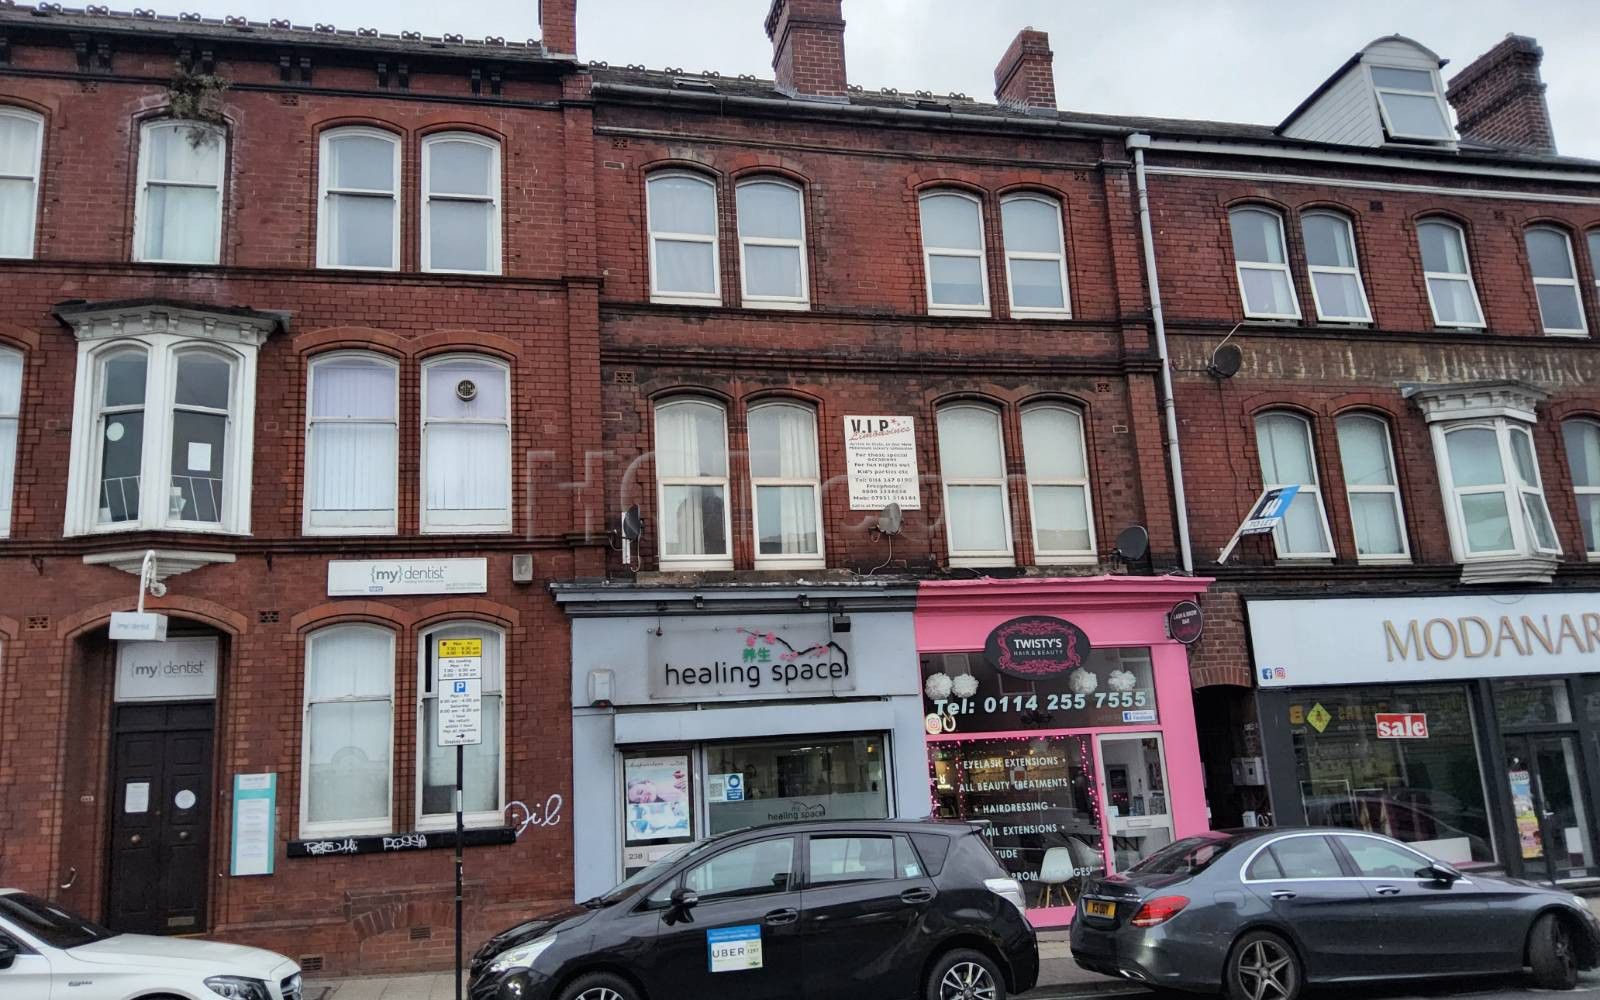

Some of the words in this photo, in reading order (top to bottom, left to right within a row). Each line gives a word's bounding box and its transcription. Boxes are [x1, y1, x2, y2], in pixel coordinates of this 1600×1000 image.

[1013, 638, 1063, 649] TWISTY'S
[665, 661, 760, 687] healing
[772, 662, 843, 685] space
[934, 698, 975, 716] Tel:
[984, 696, 1038, 713] 0114
[1047, 694, 1086, 710] 255
[1094, 692, 1146, 708] 7555
[1378, 715, 1425, 737] sale
[963, 758, 1003, 769] EYELASH
[1005, 756, 1059, 768] EXTENSIONS
[958, 783, 975, 793] ALL
[977, 781, 1011, 792] BEAUTY
[1014, 778, 1068, 789] TREATMENTS
[982, 802, 1049, 814] HAIRDRESSING
[768, 811, 799, 821] healing
[1003, 824, 1058, 836] EXTENSIONS
[713, 947, 745, 958] UBER
